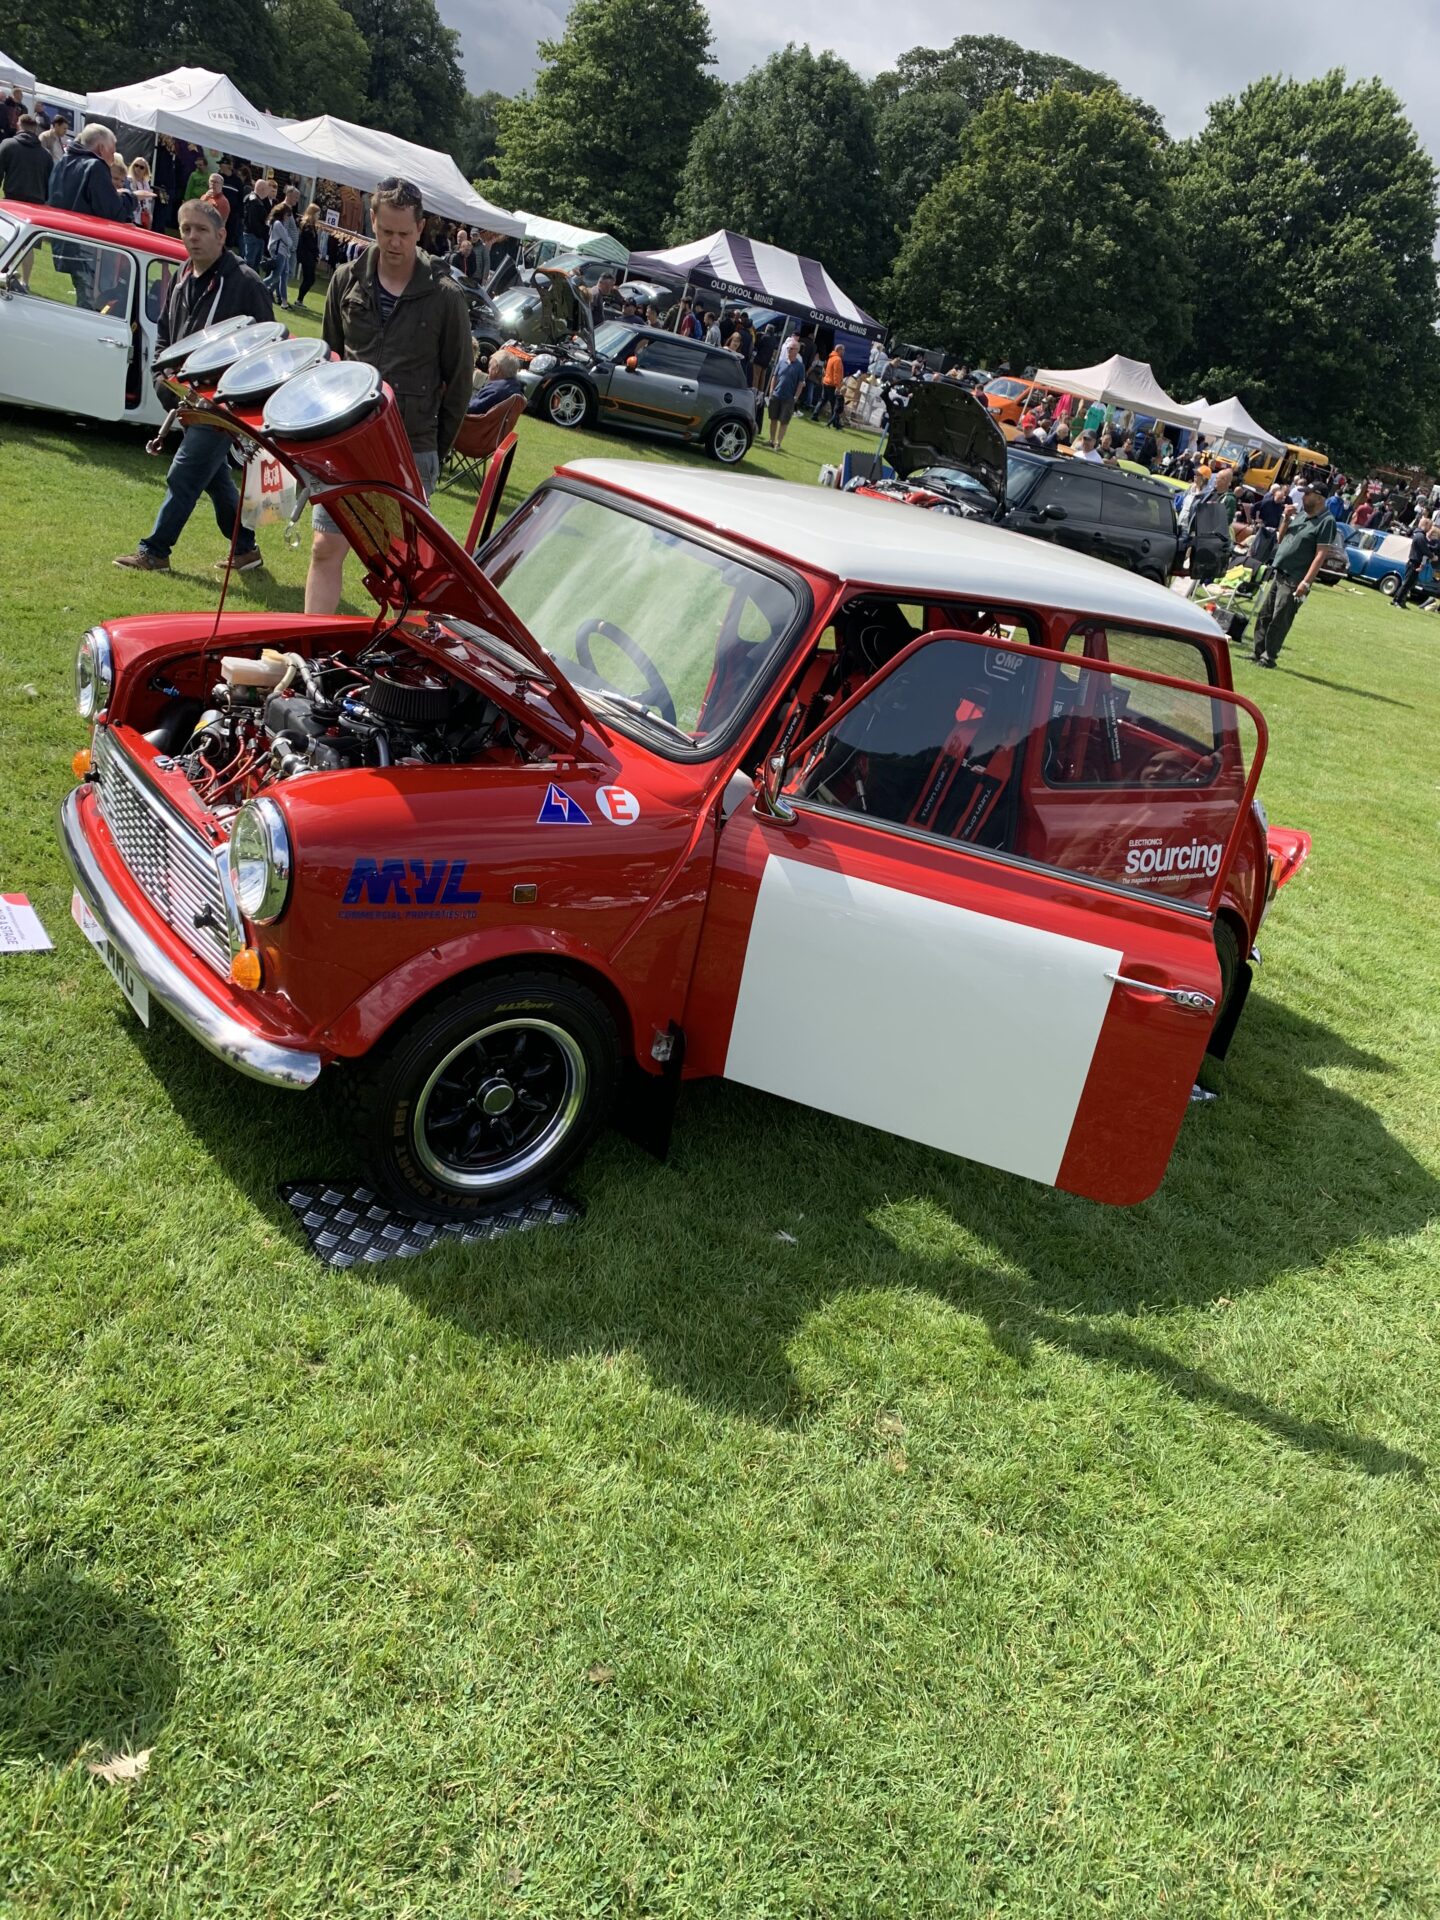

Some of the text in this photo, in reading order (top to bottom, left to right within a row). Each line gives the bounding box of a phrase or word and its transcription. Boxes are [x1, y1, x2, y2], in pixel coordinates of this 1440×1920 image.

[211, 112, 256, 127] VAGABOND
[710, 279, 774, 306] OLD SKOOL MINIS
[809, 310, 867, 336] OLD SKOOL MINIS
[995, 652, 1024, 670] OMP
[602, 788, 634, 820] E
[1128, 838, 1163, 847] ELECTRONICS
[1124, 838, 1223, 877] sourcing
[1131, 876, 1151, 885] magazine
[1157, 874, 1180, 882] purchasing
[336, 910, 401, 920] COMMERCIAL
[405, 910, 461, 920] PROPERTIES
[1, 925, 19, 945] STAGE
[393, 1143, 436, 1200] SPORT
